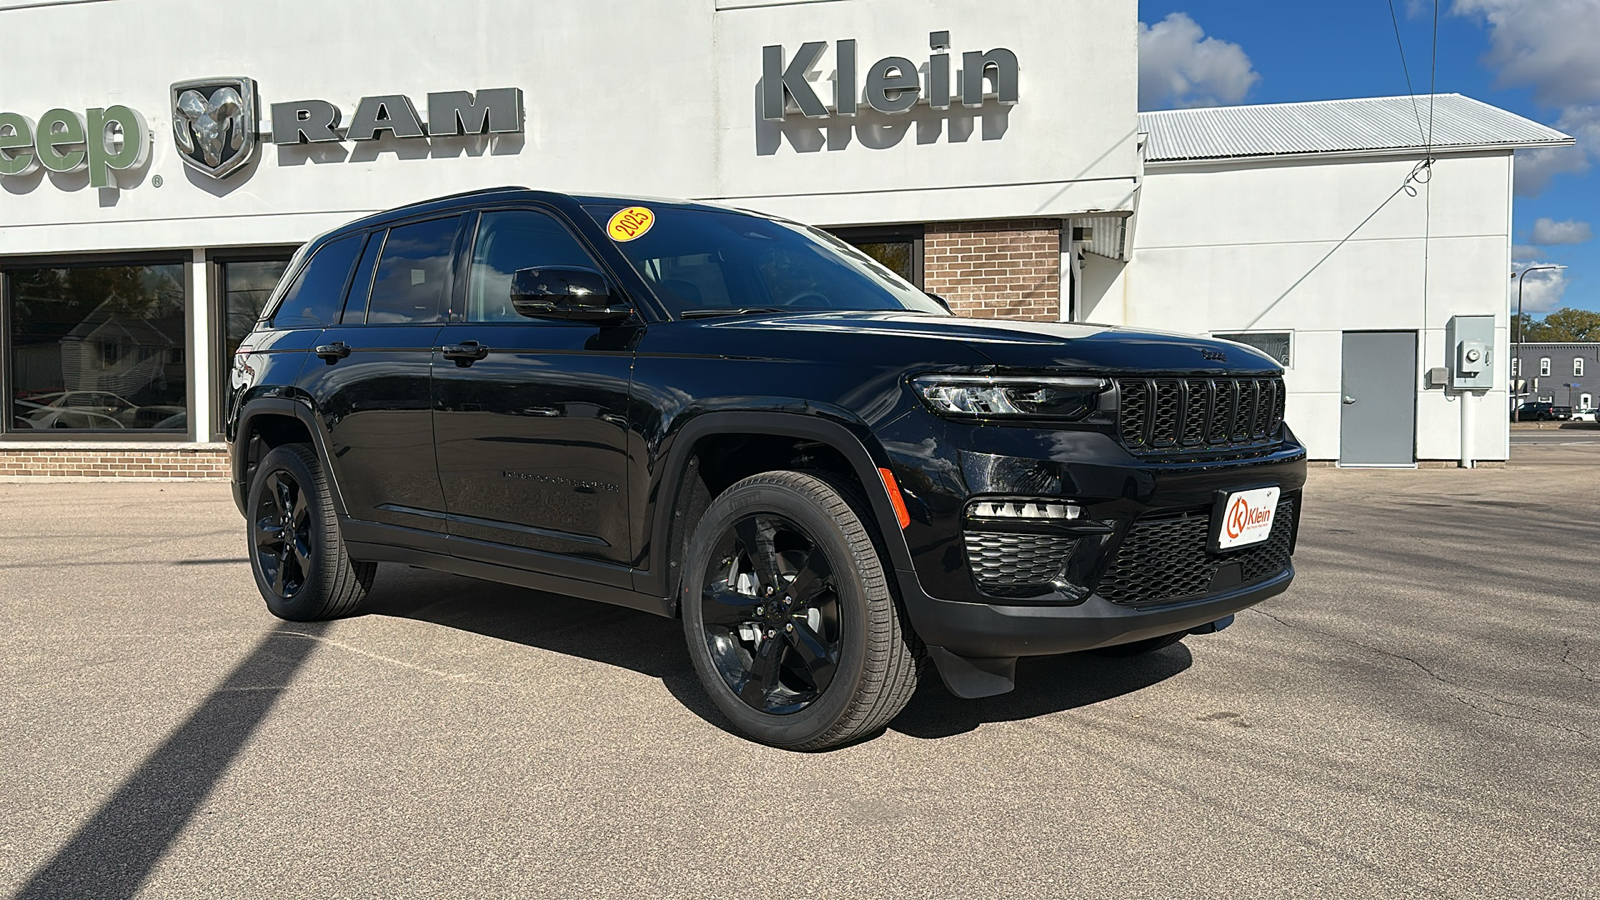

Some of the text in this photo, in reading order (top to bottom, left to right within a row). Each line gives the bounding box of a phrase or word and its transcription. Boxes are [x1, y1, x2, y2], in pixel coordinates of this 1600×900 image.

[762, 30, 1019, 120] Klein
[270, 87, 522, 145] RAM
[615, 209, 649, 237] 2025
[1247, 506, 1271, 526] Klein
